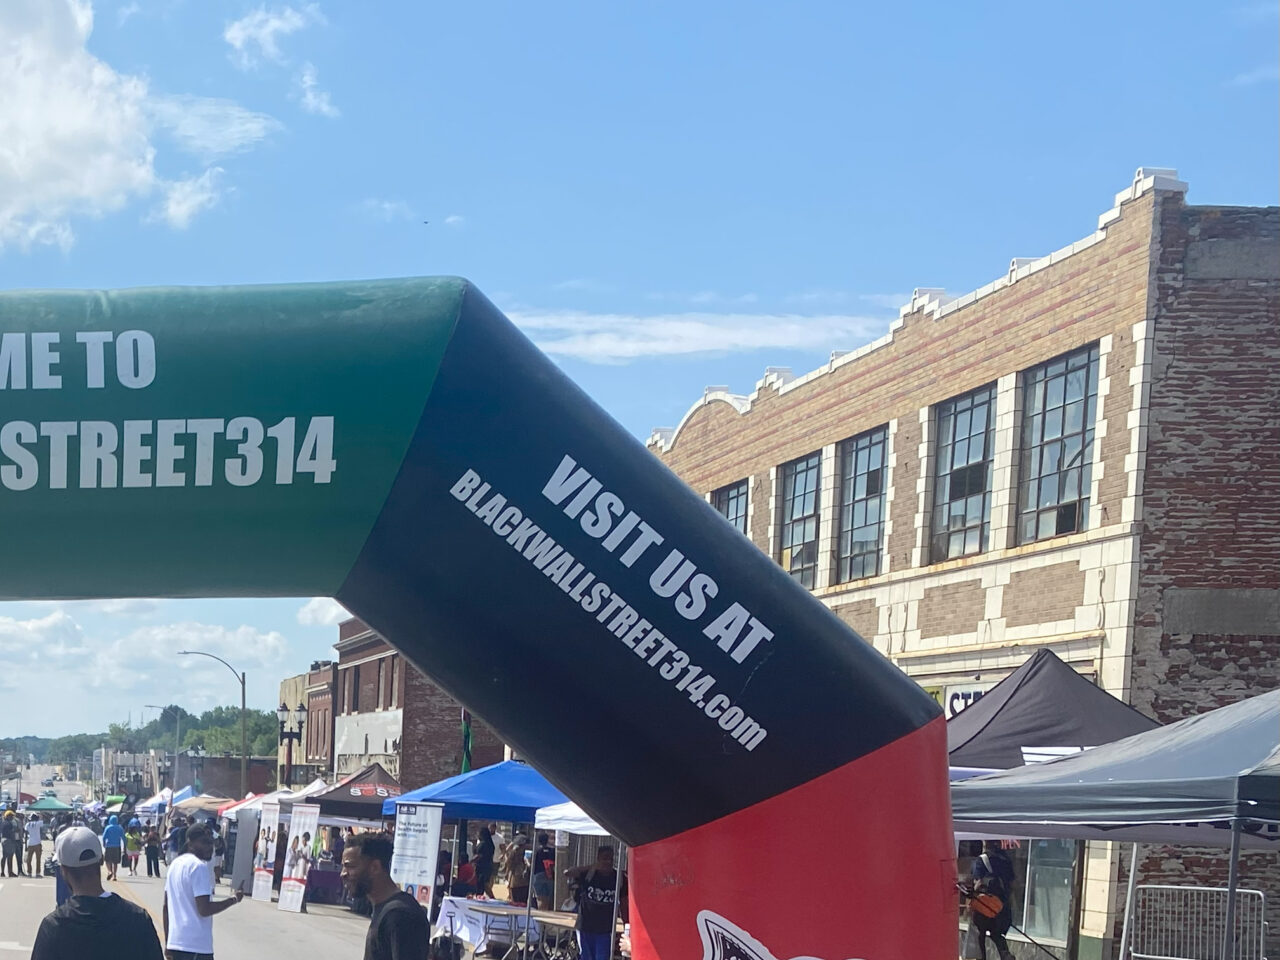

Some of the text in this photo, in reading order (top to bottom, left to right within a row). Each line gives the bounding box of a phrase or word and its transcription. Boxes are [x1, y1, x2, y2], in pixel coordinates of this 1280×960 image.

[75, 329, 158, 389] TO
[449, 467, 768, 752] BLACKWALLSTREET314.com
[541, 453, 776, 665] VISIT US AT
